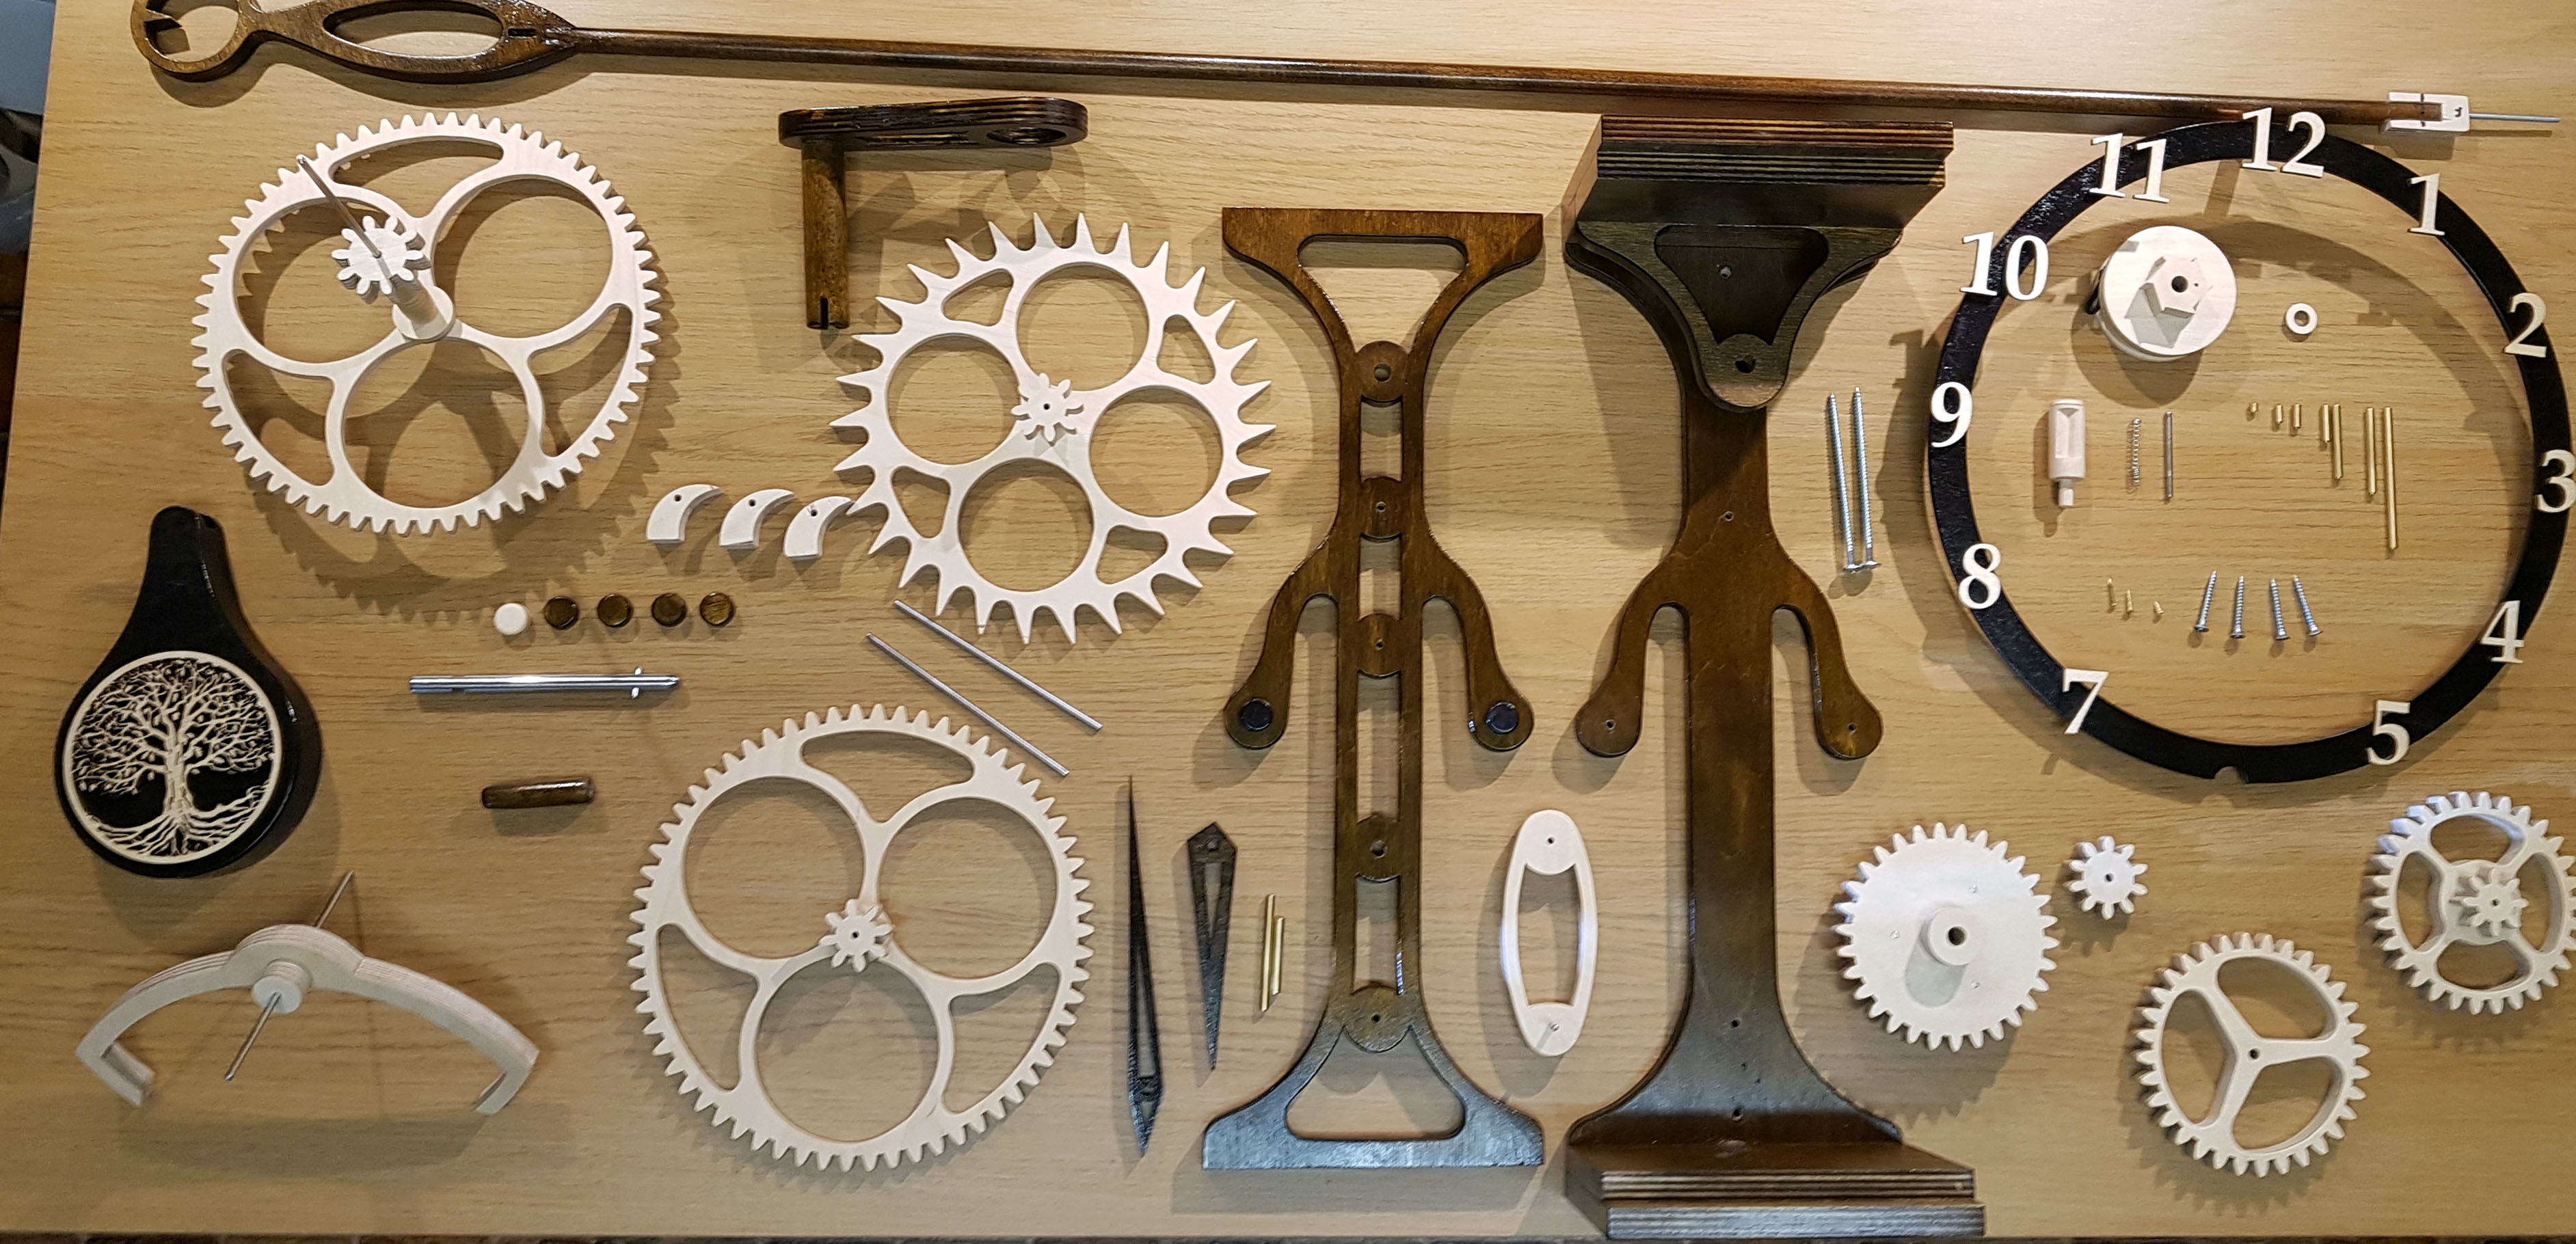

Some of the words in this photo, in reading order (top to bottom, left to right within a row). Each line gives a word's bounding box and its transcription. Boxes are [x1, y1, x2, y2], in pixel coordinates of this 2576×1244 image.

[2089, 133, 2171, 203] 11
[2242, 107, 2326, 177] 12
[2409, 173, 2445, 236] 1
[1960, 231, 2049, 301] 10
[2504, 293, 2547, 357] 2
[1931, 381, 1973, 447] 9
[2536, 450, 2576, 513] 3
[1959, 543, 2001, 609] 8
[2480, 600, 2524, 664] 4
[2062, 668, 2109, 735] 7
[2367, 700, 2411, 766] 5
